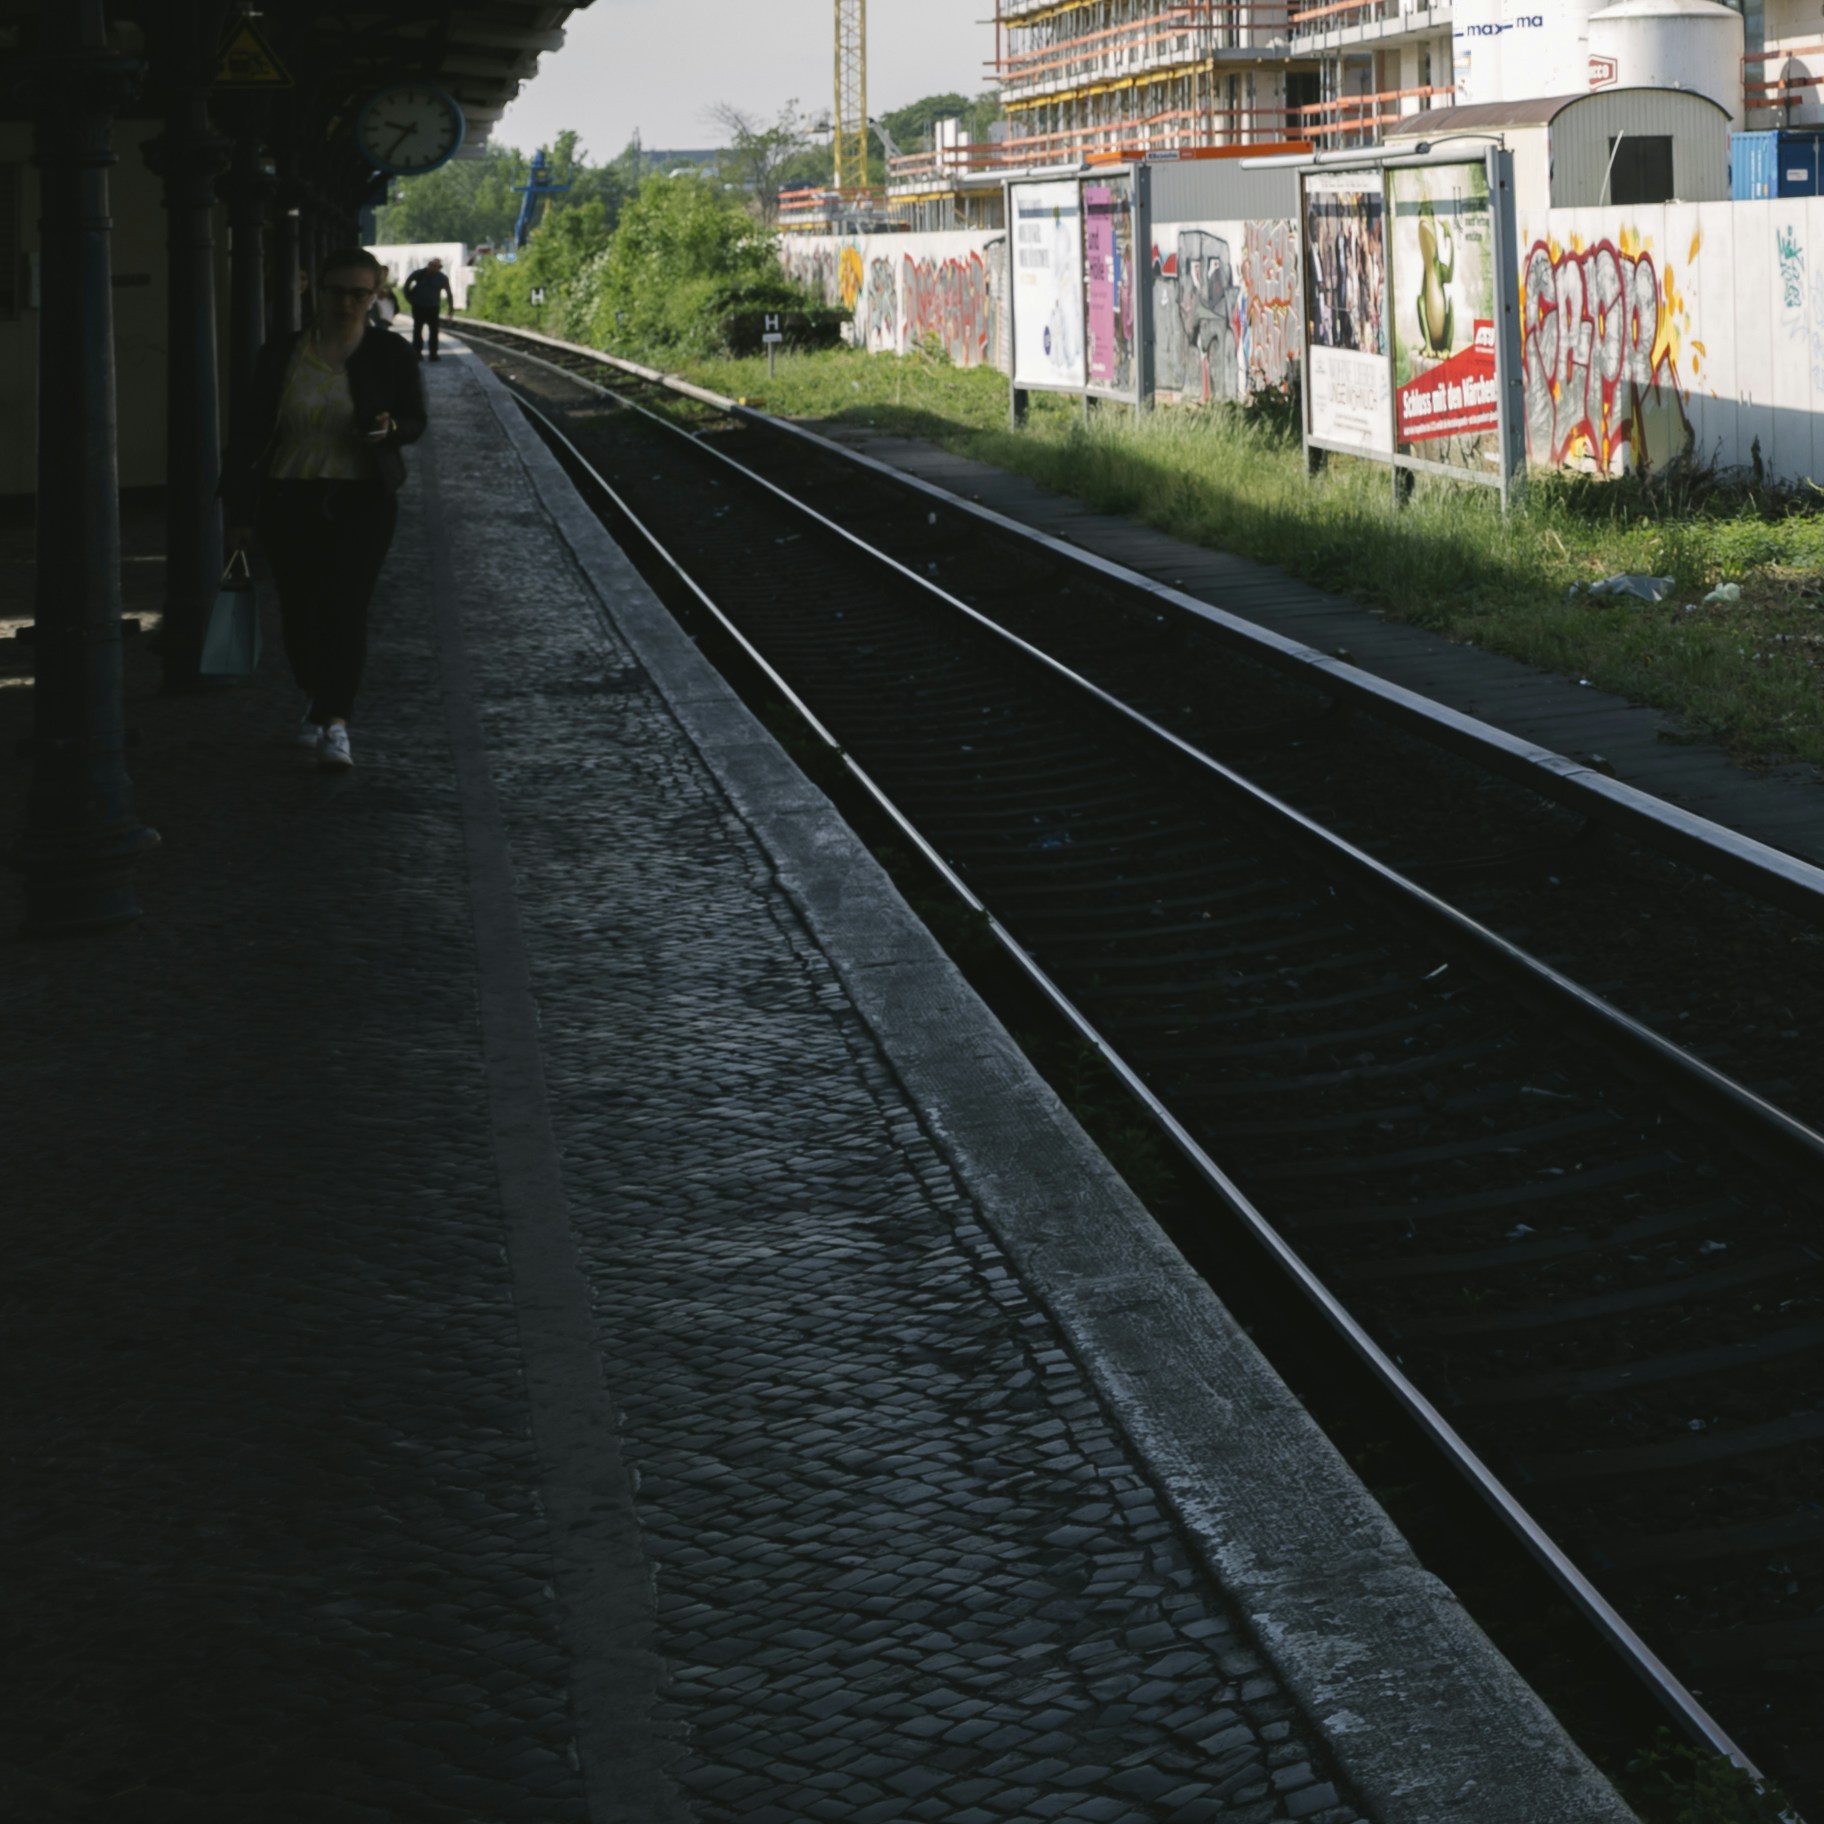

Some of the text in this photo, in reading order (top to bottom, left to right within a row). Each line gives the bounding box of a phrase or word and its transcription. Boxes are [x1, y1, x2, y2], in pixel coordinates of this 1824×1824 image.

[531, 287, 545, 305] H
[765, 314, 780, 333] H
[1402, 388, 1431, 419] Schluss
[1432, 382, 1447, 413] mit
[1447, 380, 1463, 411] den
